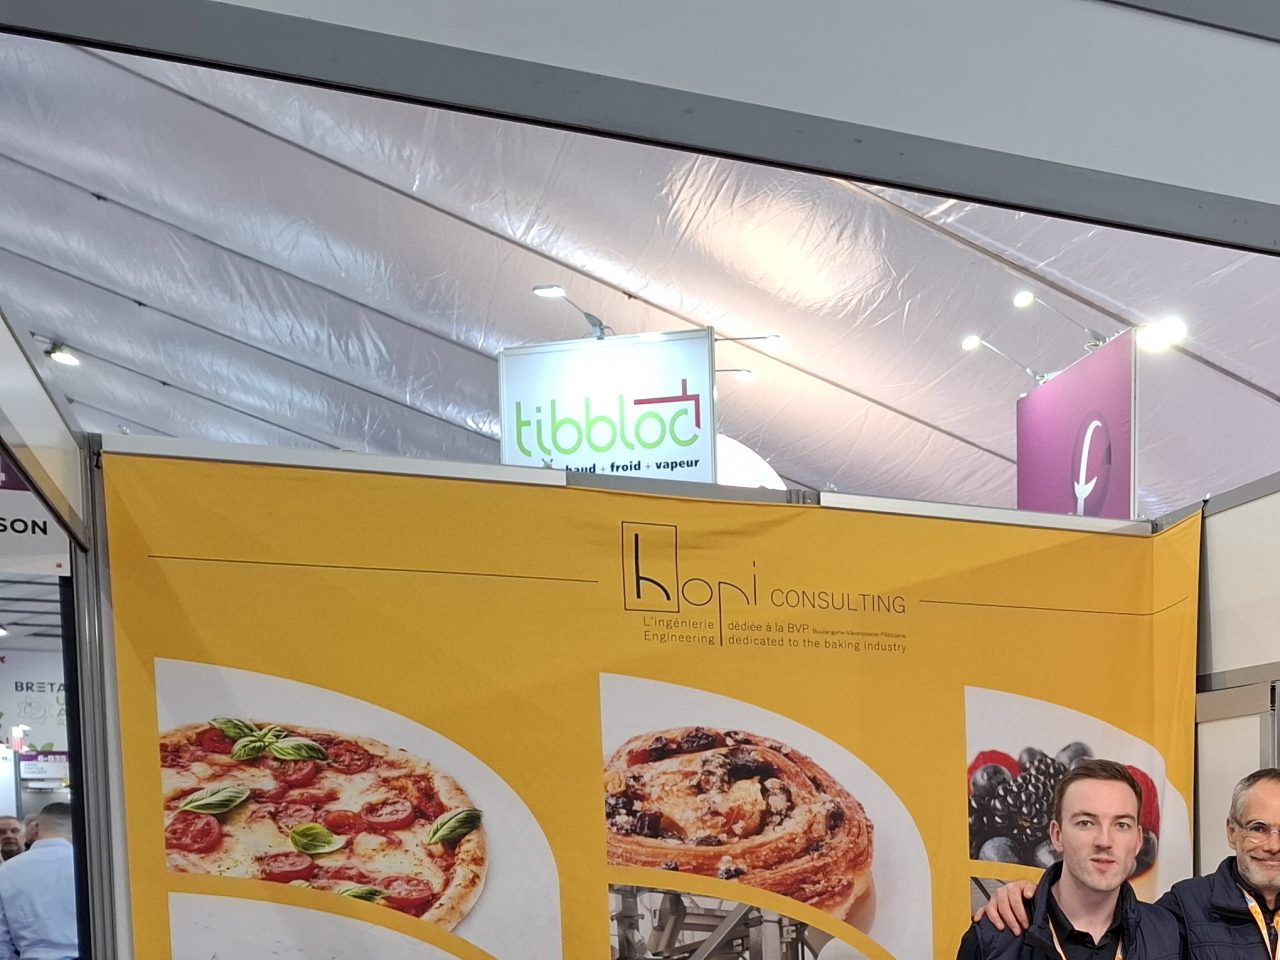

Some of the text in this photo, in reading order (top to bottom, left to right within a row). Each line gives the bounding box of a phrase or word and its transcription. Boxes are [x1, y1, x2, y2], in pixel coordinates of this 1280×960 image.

[515, 394, 699, 457] tibbloc
[565, 464, 596, 473] haud
[610, 460, 641, 472] froid
[655, 458, 700, 471] vapeur
[634, 532, 907, 647] hopi CONSULTING
[643, 616, 715, 630] L'ingénierie
[727, 620, 763, 632] dédiée
[765, 621, 772, 632] à
[774, 621, 785, 633] la
[787, 622, 810, 634] BVP
[643, 630, 907, 654] Engineering dedicated to the baking industry
